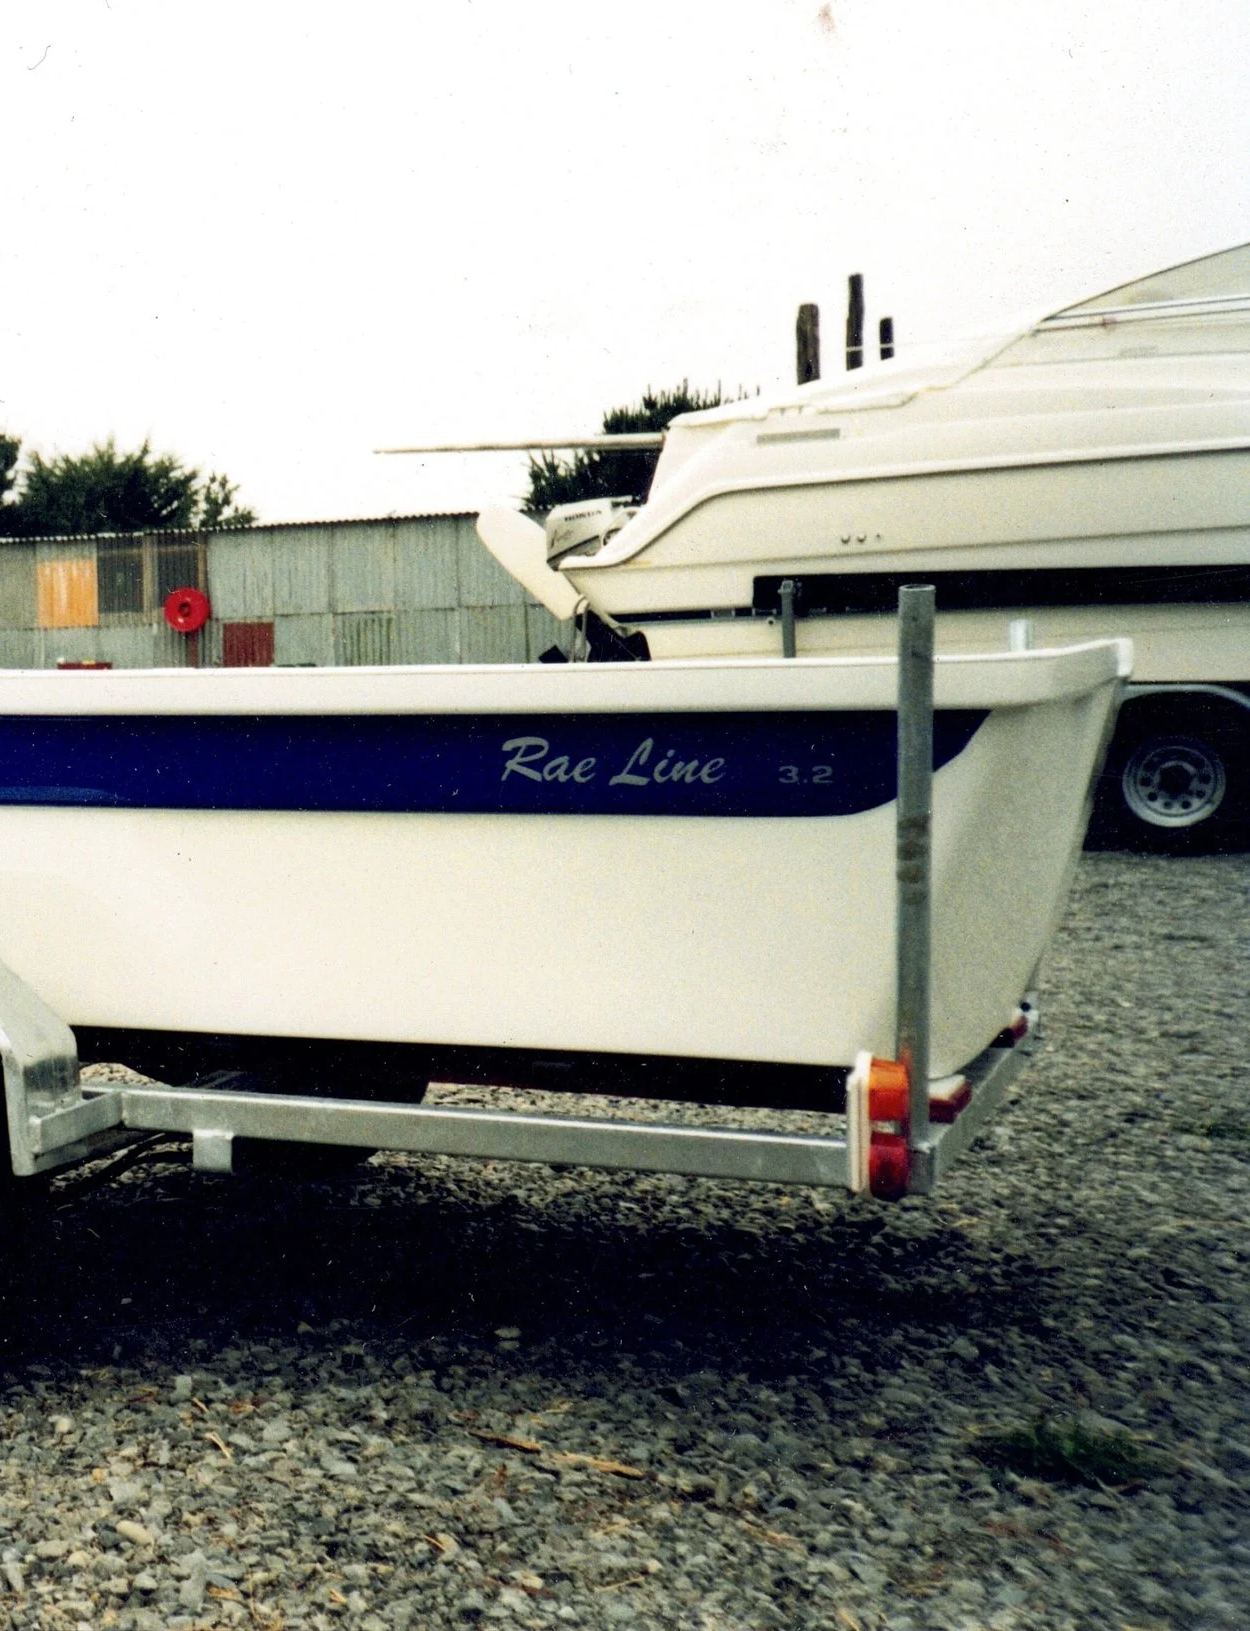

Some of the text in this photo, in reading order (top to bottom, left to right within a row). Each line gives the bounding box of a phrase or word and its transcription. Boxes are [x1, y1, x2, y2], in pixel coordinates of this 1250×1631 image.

[501, 736, 726, 786] Rae Line
[779, 766, 833, 784] 3.2
